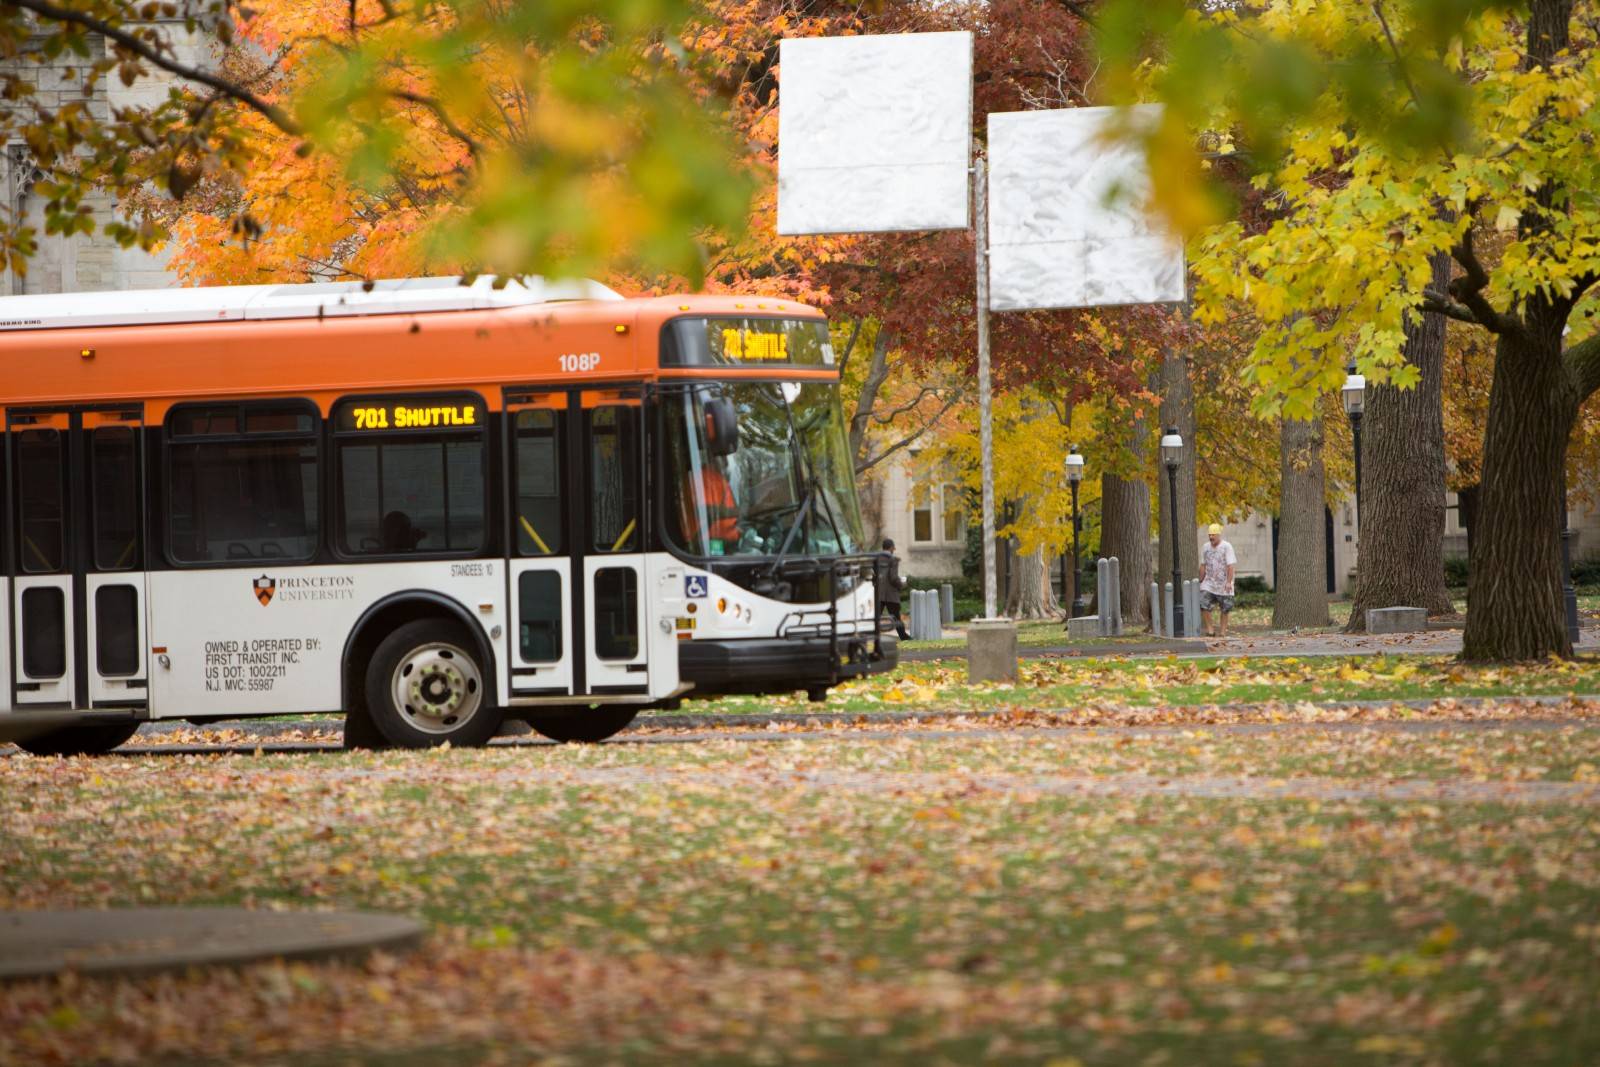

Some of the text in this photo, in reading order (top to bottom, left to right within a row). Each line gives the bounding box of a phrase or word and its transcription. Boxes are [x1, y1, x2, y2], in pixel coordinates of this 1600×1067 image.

[558, 352, 601, 372] 108P
[353, 406, 475, 429] 701 SHUTTLE
[279, 576, 355, 588] PRINCETON
[279, 589, 355, 601] UNIVERSITY
[205, 638, 321, 653] OWNED & OPERATED BY:
[205, 651, 300, 665] FIRST TRANSIT INC.
[205, 664, 286, 679] US DOT: 1002211
[248, 678, 274, 691] 55987
